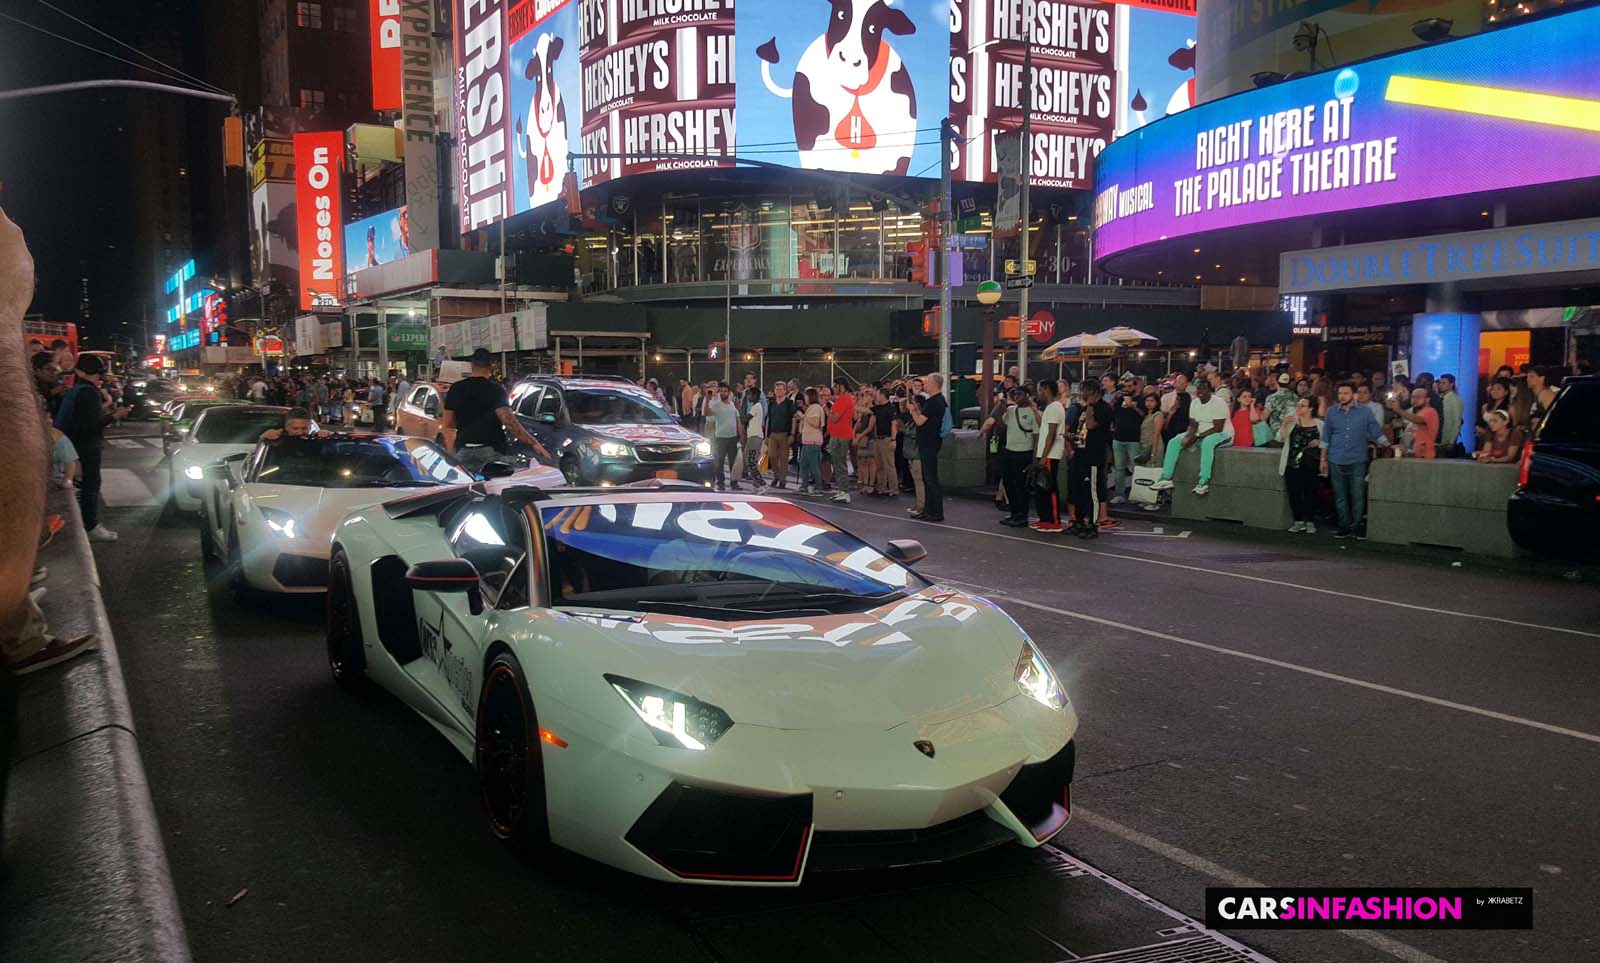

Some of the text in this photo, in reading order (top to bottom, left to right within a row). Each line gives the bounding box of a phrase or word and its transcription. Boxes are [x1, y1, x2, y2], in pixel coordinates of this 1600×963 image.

[653, 12, 717, 26] MILK CHOCOLATE
[993, 0, 1109, 54] HERSHEY'S
[1041, 47, 1076, 59] CHOCOLATE
[585, 40, 670, 112] HERSHEY'S
[995, 62, 1111, 119] HERSHEY'S
[608, 97, 634, 111] CHOCOLATE
[1041, 114, 1078, 124] CHOCOLATE
[1196, 96, 1355, 171] RIGHT HERE AT
[308, 147, 330, 190] On
[459, 116, 470, 226] CHOCOLATE
[656, 159, 719, 171] MILK CHOCOLATE
[1037, 177, 1073, 188] CHOCOLATE
[1174, 136, 1399, 217] THE PALACE THEATRE
[1119, 181, 1155, 218] MUSICAL
[312, 195, 334, 281] Noses
